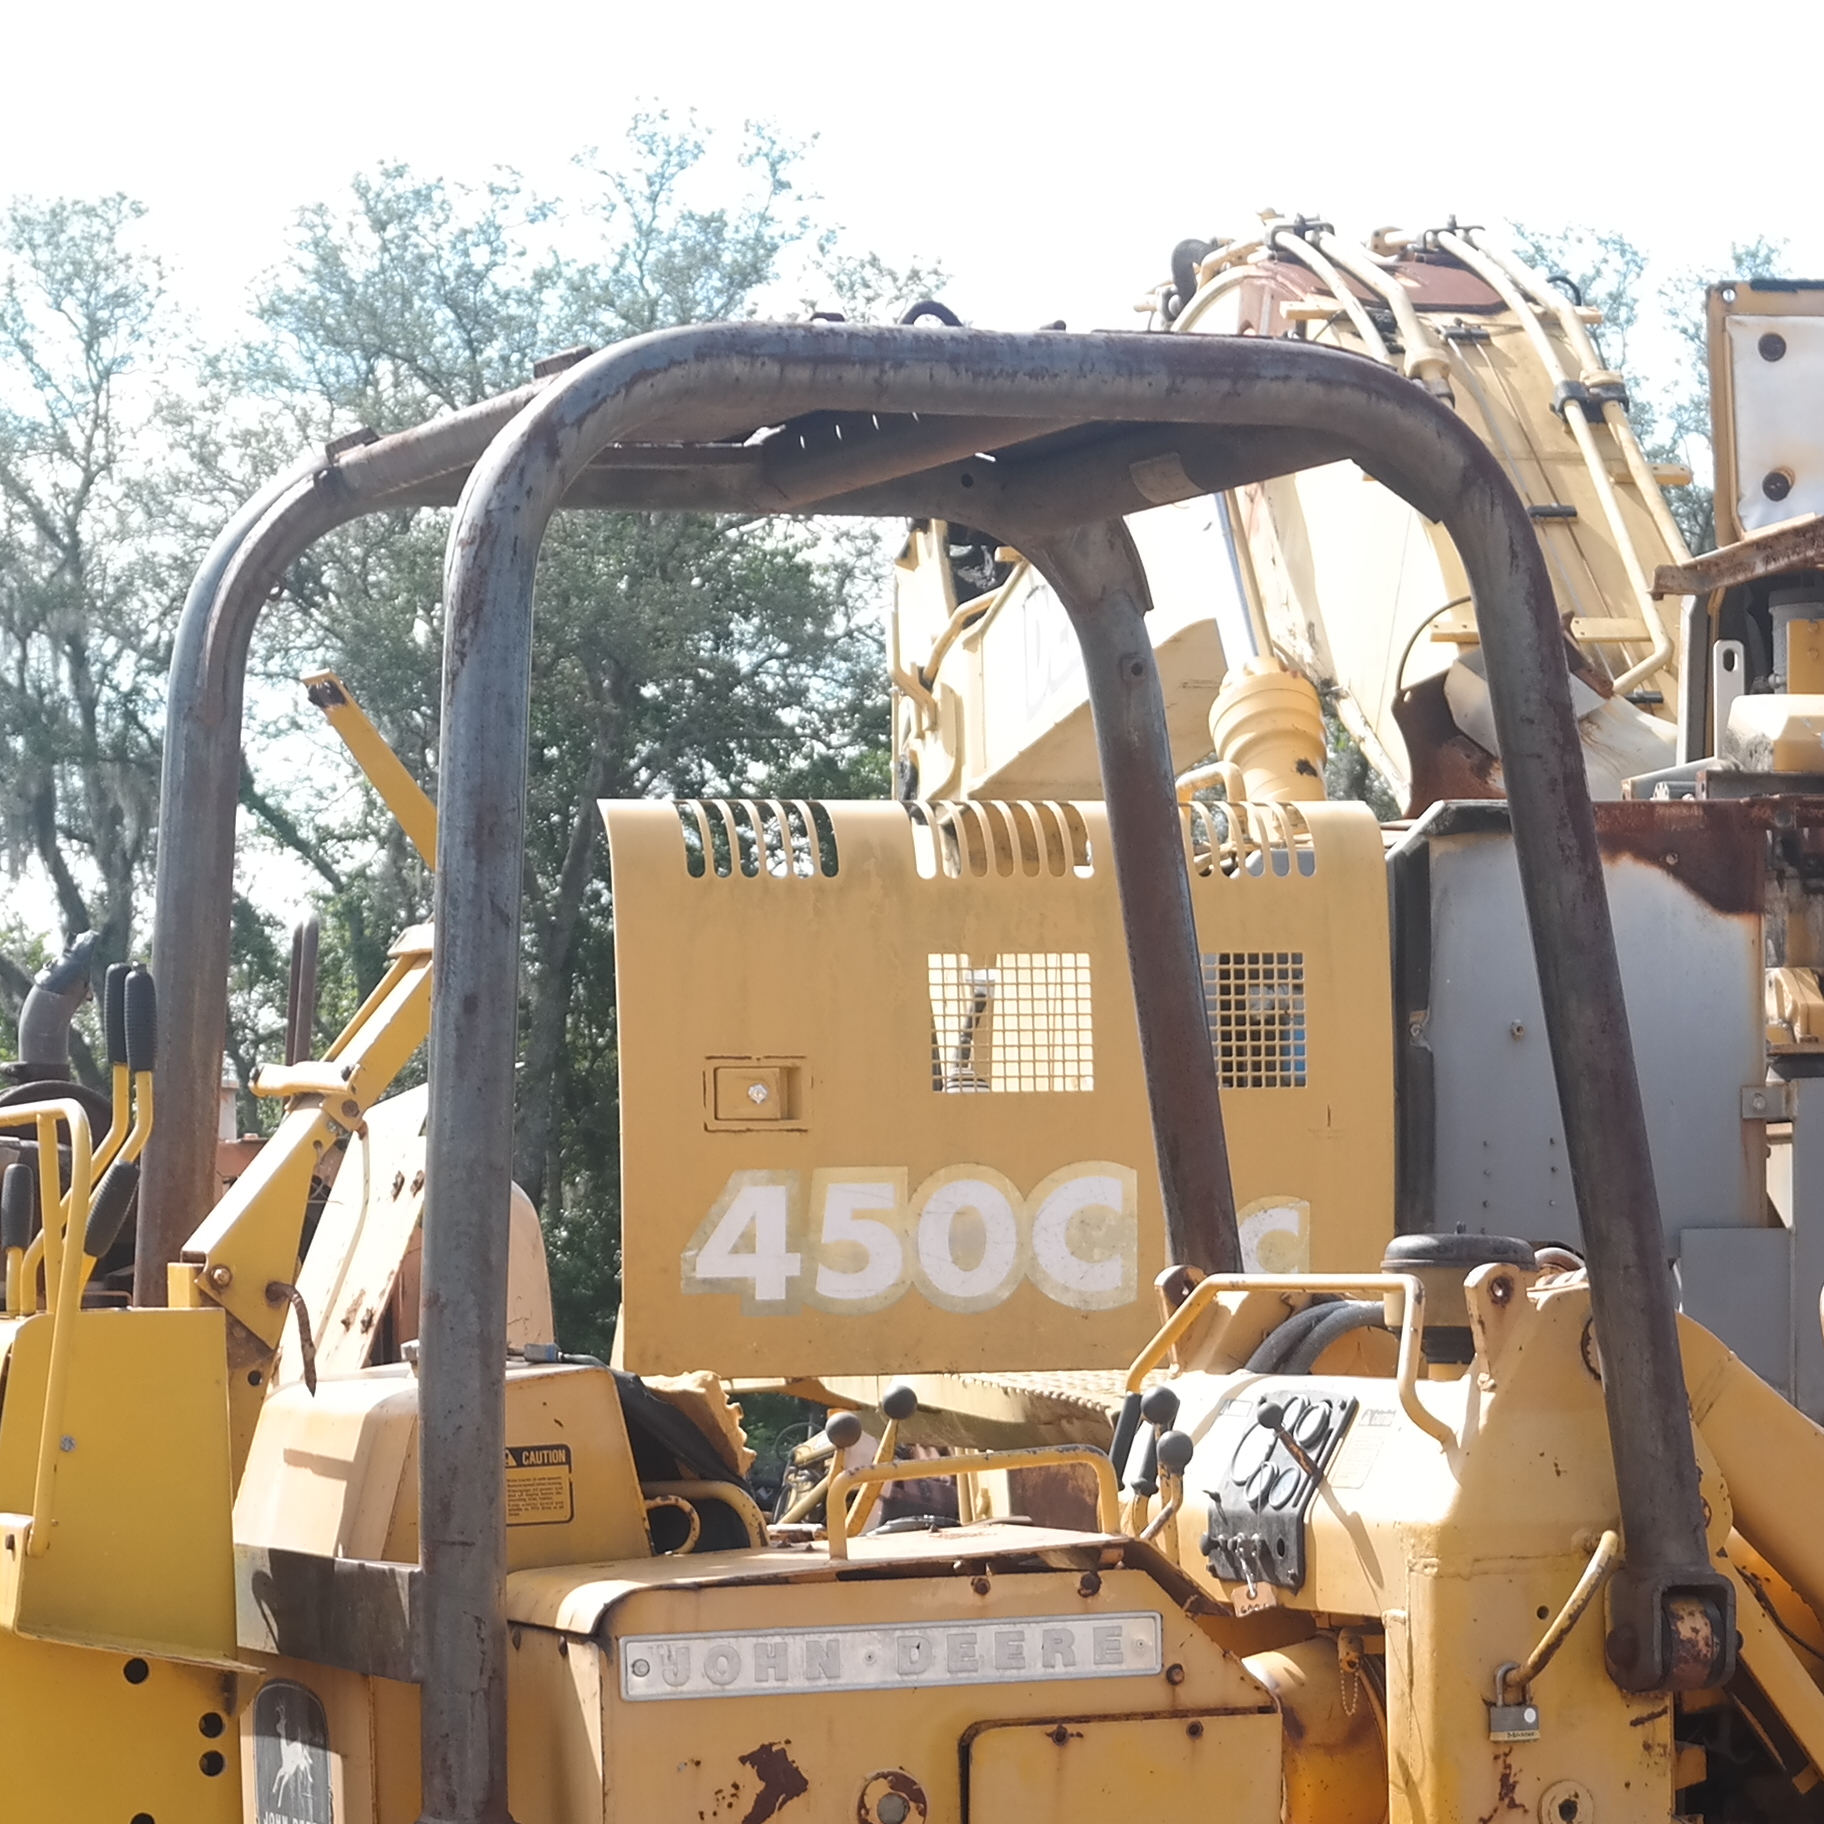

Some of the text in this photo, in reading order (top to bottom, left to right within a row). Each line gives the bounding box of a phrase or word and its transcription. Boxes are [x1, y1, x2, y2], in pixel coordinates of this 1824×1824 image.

[689, 1169, 1129, 1308] 450C
[522, 1449, 566, 1465] CAUTION
[660, 1625, 1125, 1687] JOHN DEERE
